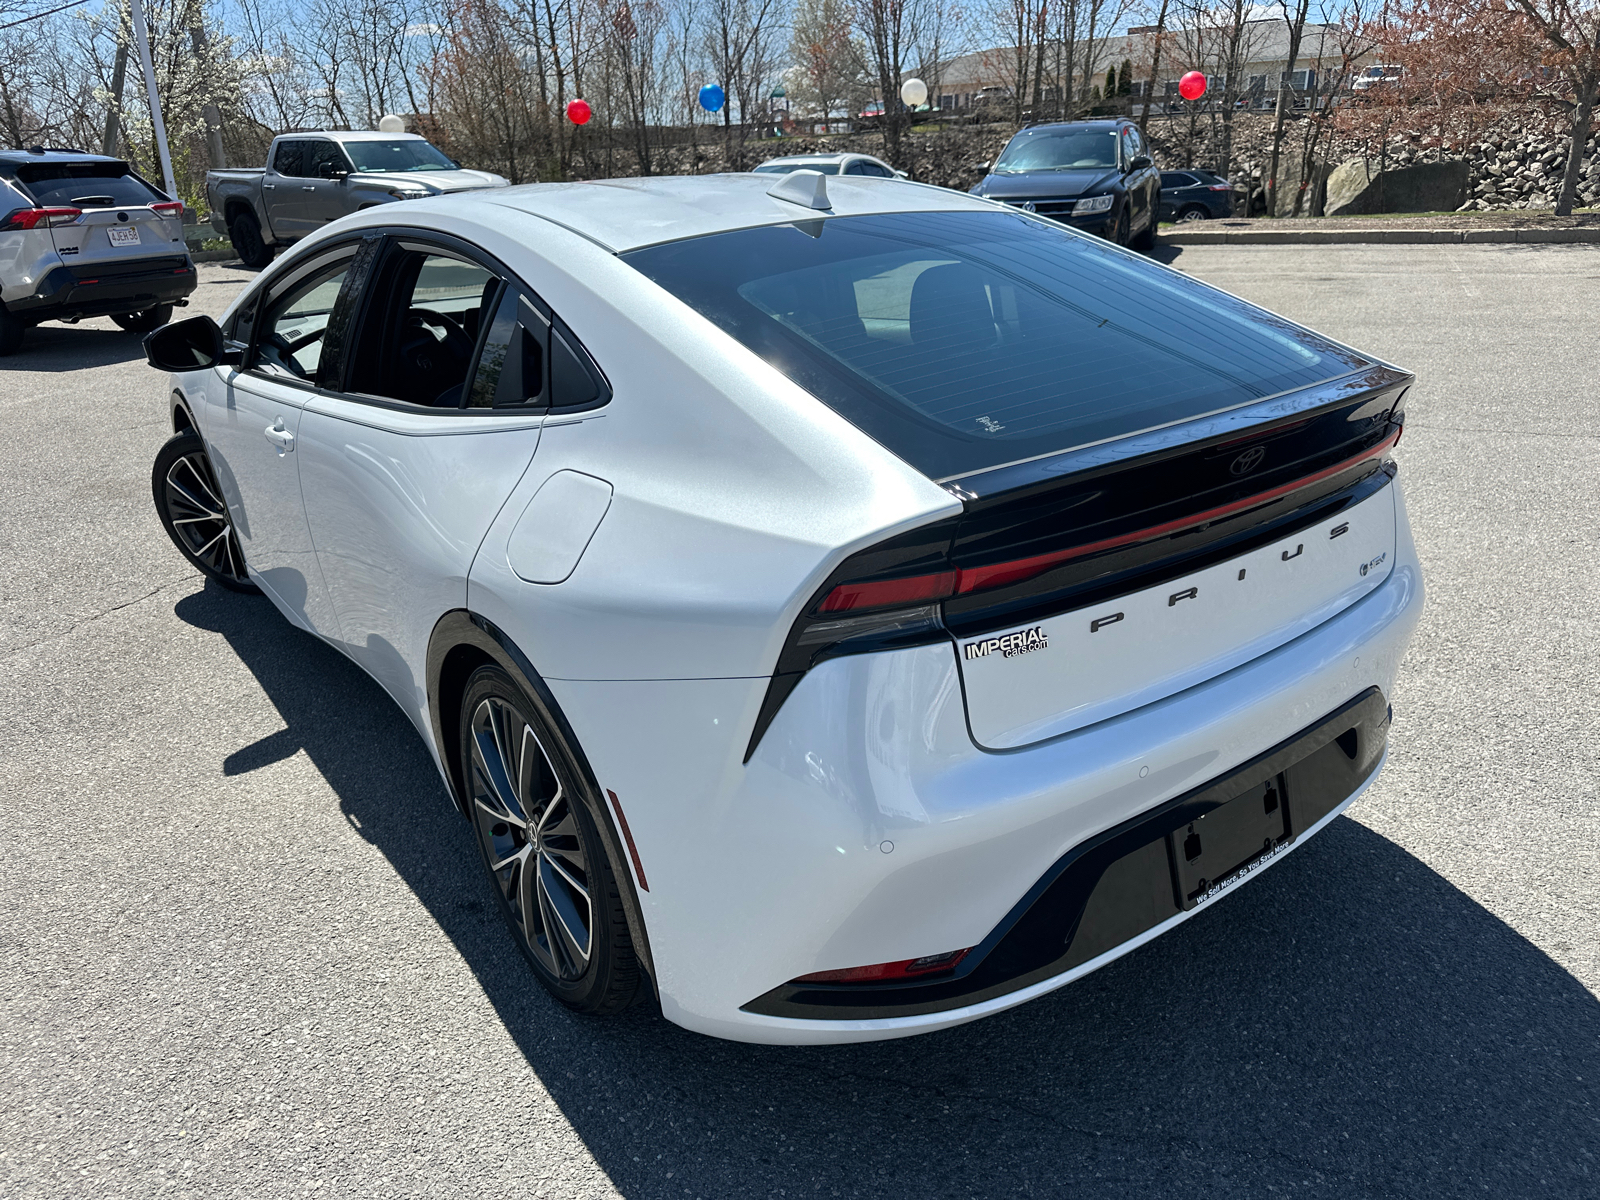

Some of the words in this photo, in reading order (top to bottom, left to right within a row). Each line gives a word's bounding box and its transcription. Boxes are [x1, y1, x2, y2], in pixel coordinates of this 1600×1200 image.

[1091, 521, 1349, 633] PRIUS
[964, 627, 1048, 660] IMPERIAL
[1004, 640, 1049, 658] cars.com
[1196, 894, 1208, 904] We
[1208, 885, 1220, 898] Sell
[1239, 869, 1248, 878] So
[1248, 861, 1260, 871] You
[1260, 851, 1274, 864] Save
[1274, 841, 1289, 854] More
